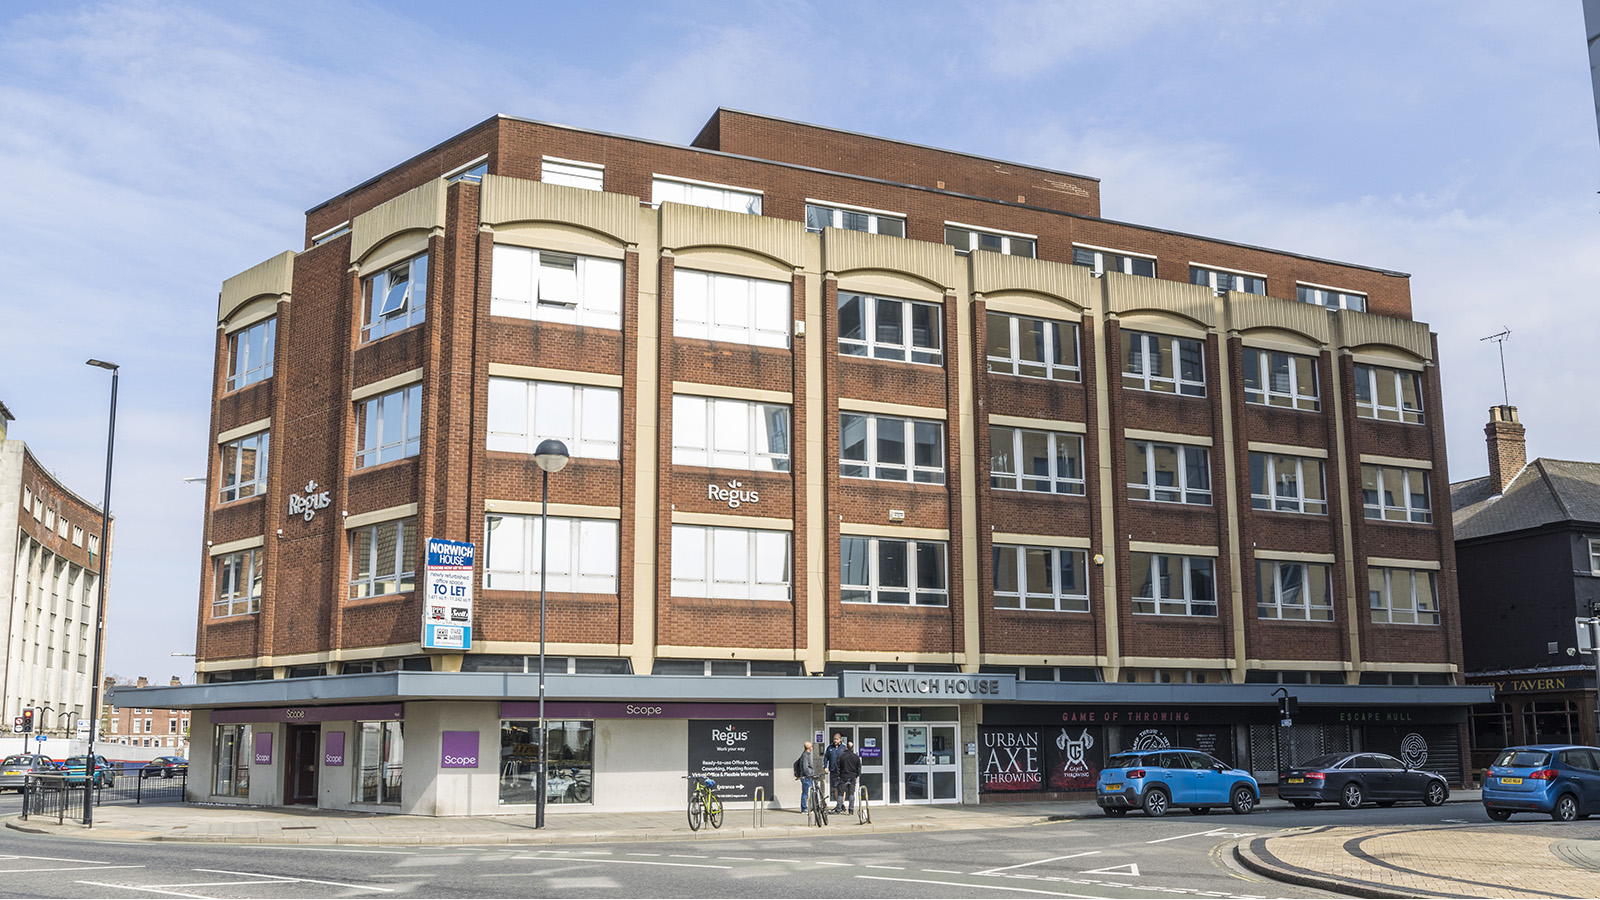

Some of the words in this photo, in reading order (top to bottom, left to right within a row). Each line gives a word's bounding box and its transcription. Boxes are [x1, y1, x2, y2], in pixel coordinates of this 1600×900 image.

[708, 484, 759, 508] Regus
[289, 491, 331, 521] Regus
[430, 542, 474, 558] NORWICH
[439, 554, 464, 566] HOUSE
[433, 583, 448, 595] TO
[450, 585, 466, 597] LET
[861, 677, 940, 694] NORWICH
[944, 679, 1000, 695] HOUSE
[1511, 677, 1566, 692] TAVERN
[286, 709, 305, 719] Scope
[626, 704, 662, 716] Scope
[1062, 711, 1095, 721] GAME
[1104, 711, 1119, 721] OF
[1127, 711, 1190, 721] THROWING
[1340, 712, 1380, 721] ESCAPE
[1386, 712, 1412, 721] HULL
[712, 729, 748, 746] Regus
[984, 732, 1038, 747] URBAN
[255, 753, 270, 763] Scope
[325, 753, 342, 763] Scope
[444, 755, 476, 766] Scope
[983, 747, 1038, 774] AXE
[983, 773, 1042, 783] THROWING
